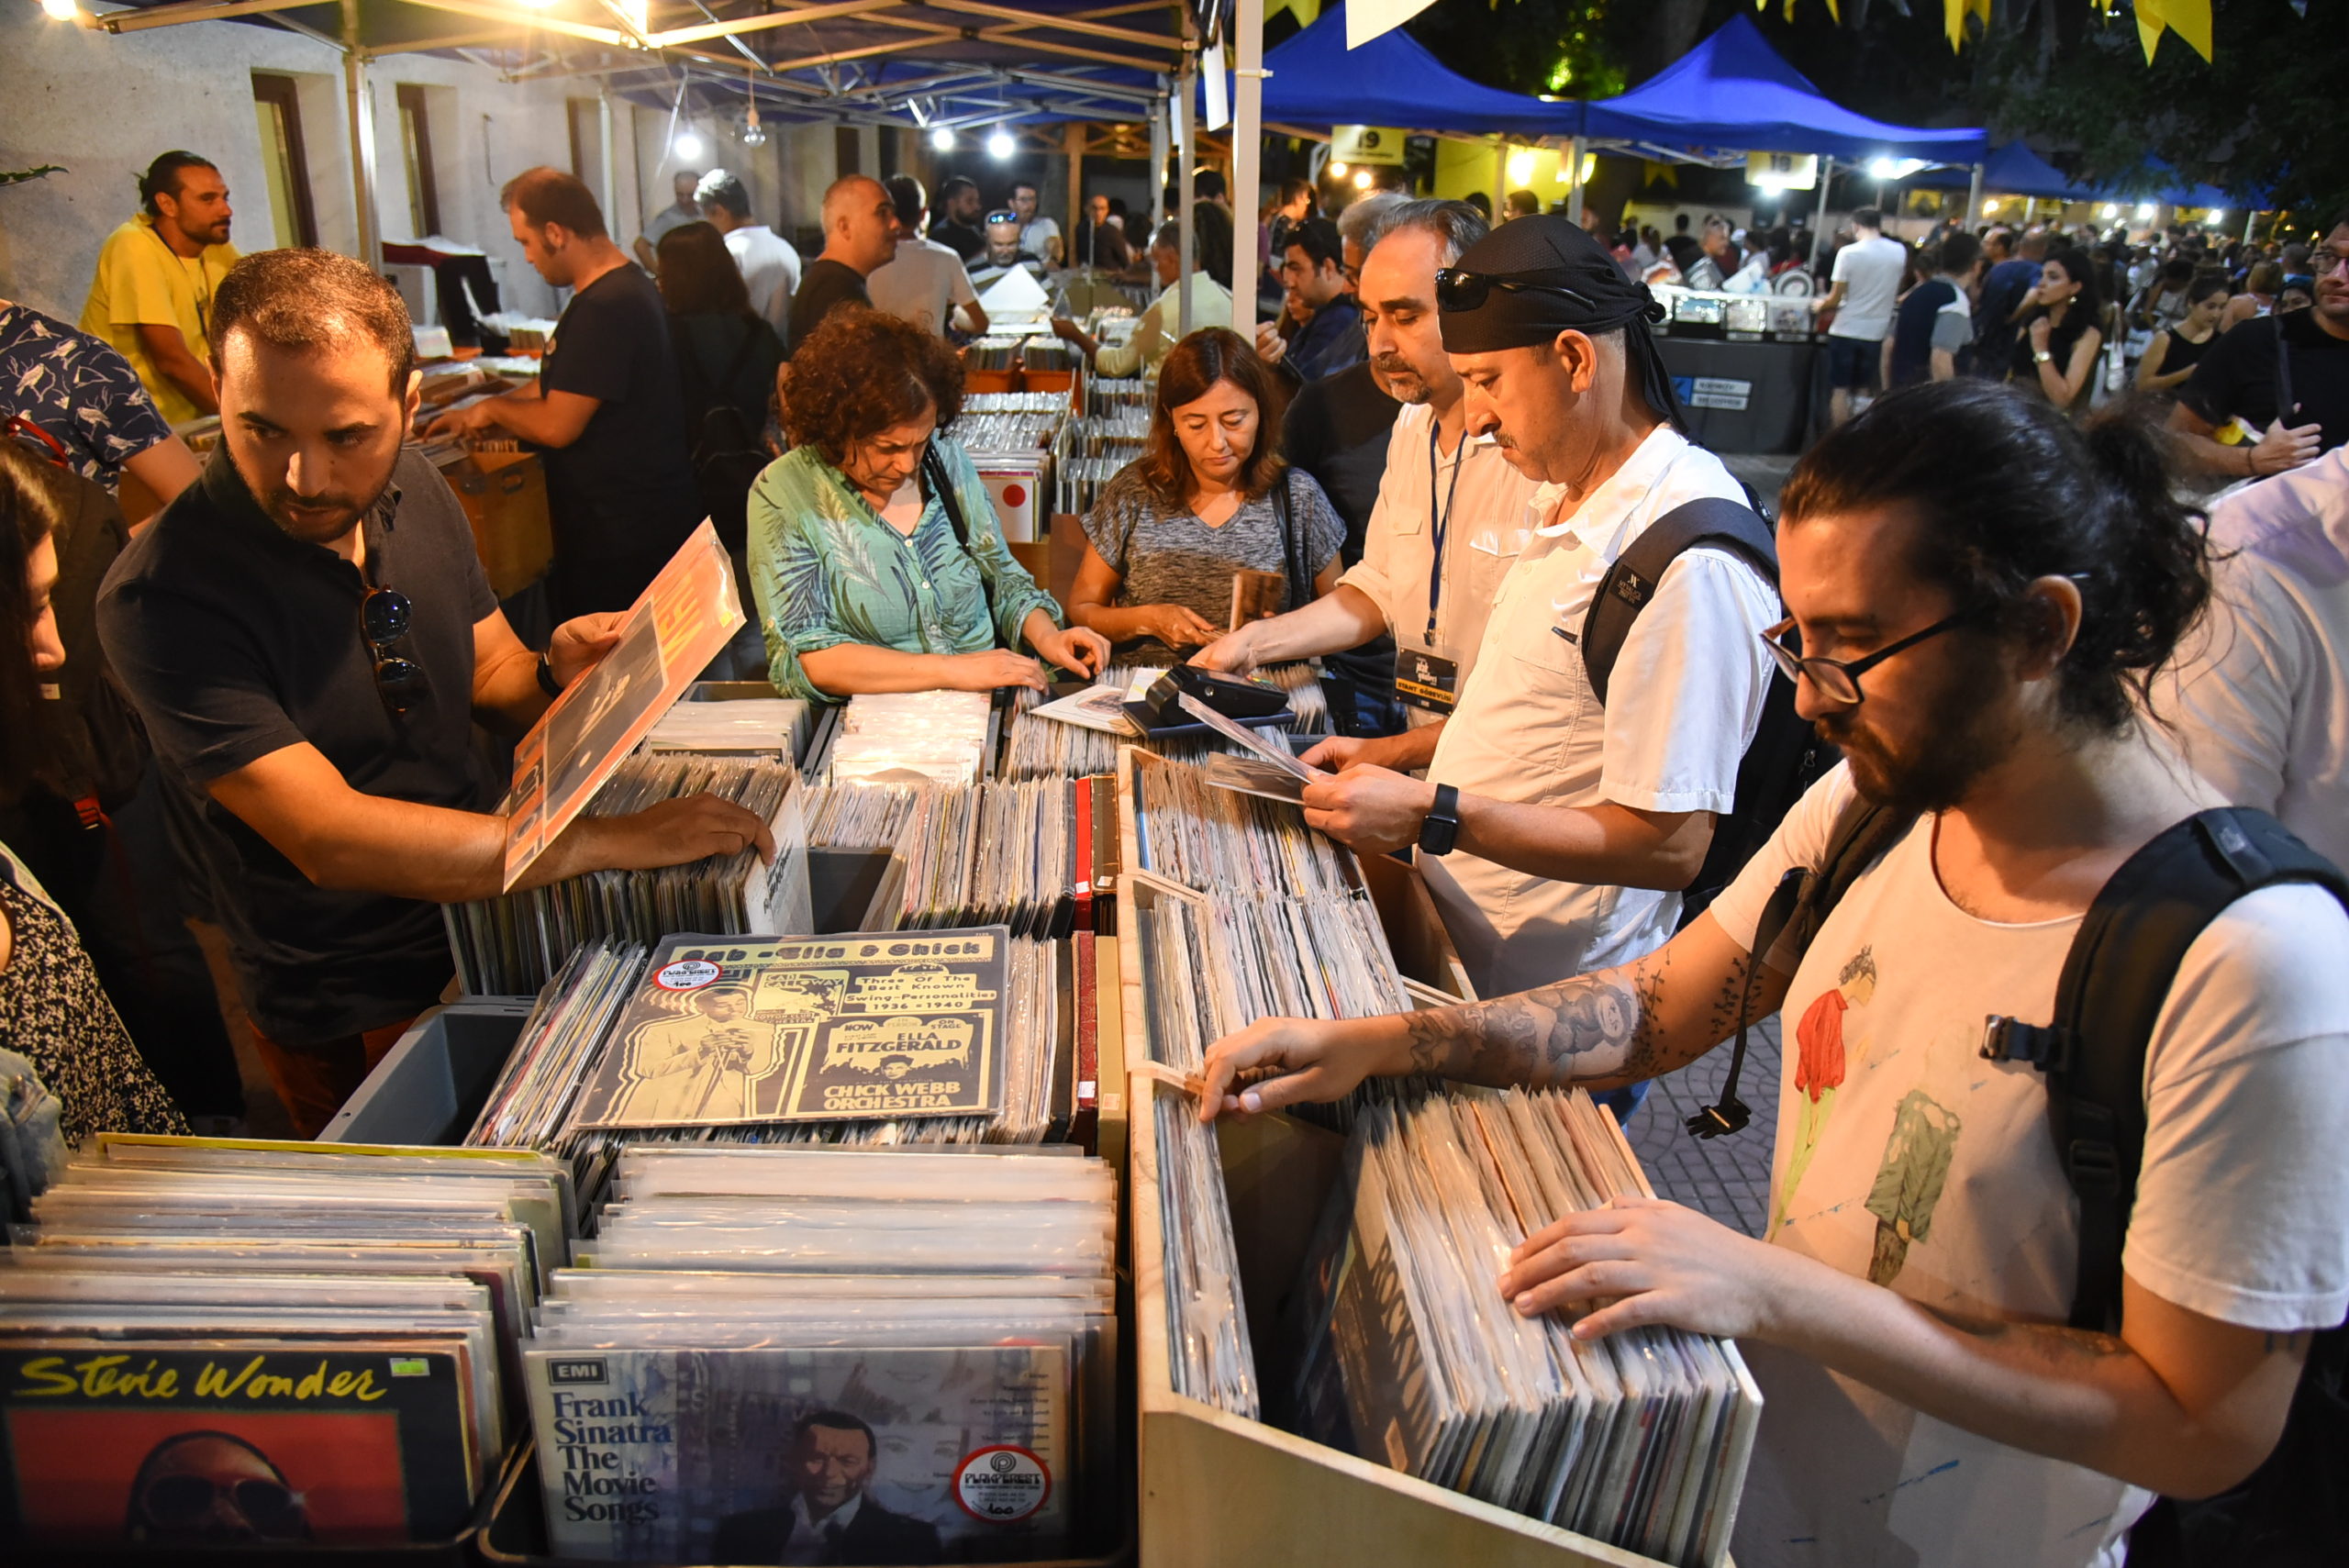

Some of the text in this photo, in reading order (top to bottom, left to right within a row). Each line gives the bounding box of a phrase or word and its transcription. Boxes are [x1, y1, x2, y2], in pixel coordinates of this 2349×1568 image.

[681, 948, 748, 962] Cab
[776, 946, 845, 960] Ella
[887, 942, 980, 956] Chick
[846, 992, 996, 1002] Swing-Personalities
[874, 1002, 908, 1010] 1936
[927, 1001, 963, 1009] 1940
[897, 1032, 939, 1040] ELLA
[836, 1039, 963, 1053] FITZGERALD
[824, 1084, 891, 1097] CHICK
[894, 1081, 962, 1095] WEBB
[824, 1095, 952, 1111] ORCHESTRA
[12, 1354, 388, 1402] Stevie Wonder
[556, 1363, 597, 1377] EMI
[552, 1391, 648, 1418] Frank
[554, 1419, 673, 1445] Sinatra
[557, 1445, 619, 1470] The
[562, 1471, 657, 1496] Movie
[564, 1496, 660, 1525] Songs
